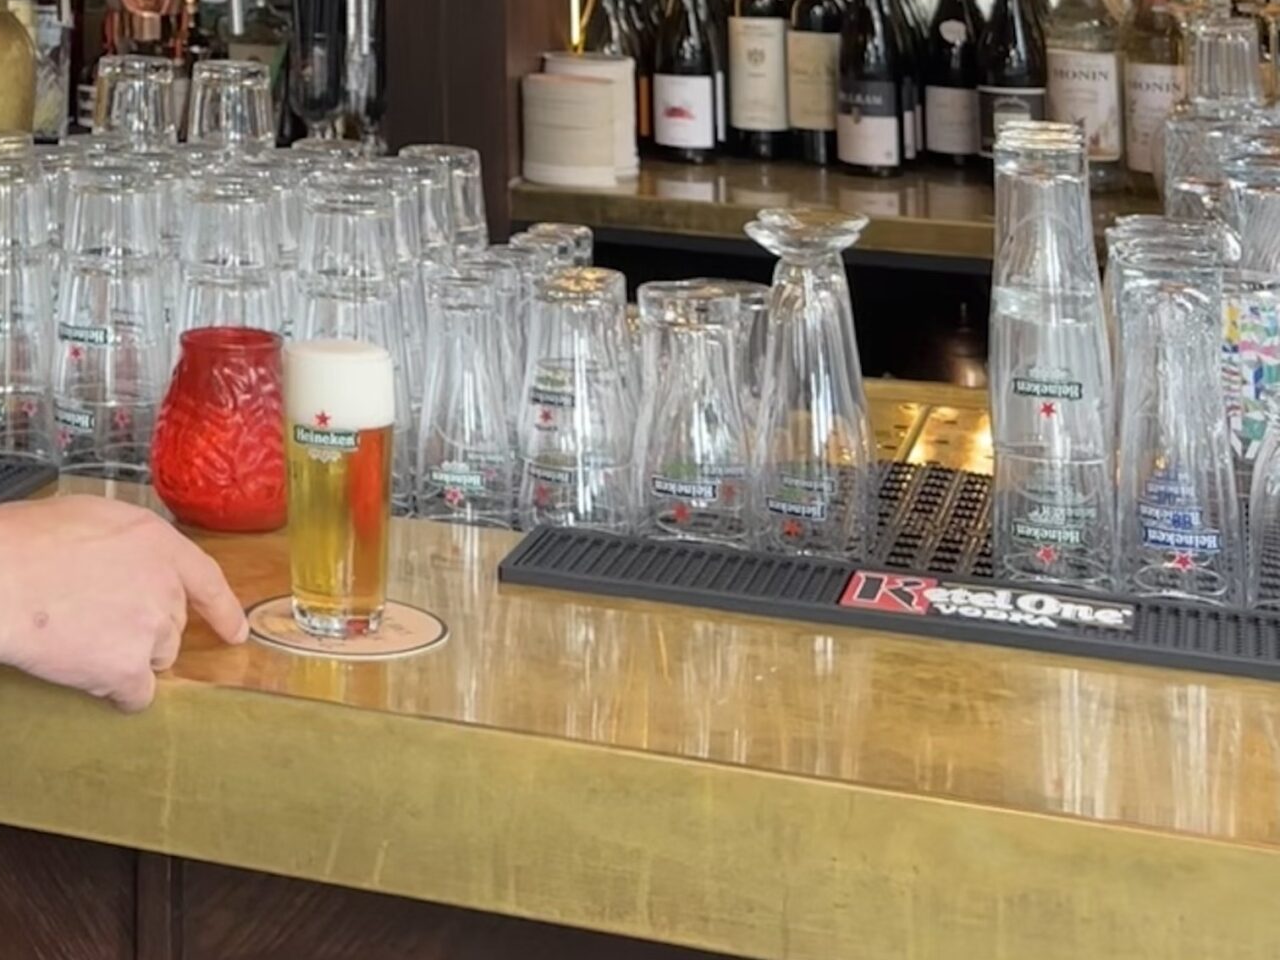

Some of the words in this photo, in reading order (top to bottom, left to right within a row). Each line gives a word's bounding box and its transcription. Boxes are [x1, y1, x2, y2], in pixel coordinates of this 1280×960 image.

[1053, 68, 1110, 82] MONIN
[1017, 379, 1080, 398] Heineken
[296, 426, 355, 448] Heineken
[655, 480, 713, 498] Heineken
[1148, 528, 1218, 549] Heineken
[853, 571, 1013, 611] Ketel
[932, 603, 1059, 628] VODKA
